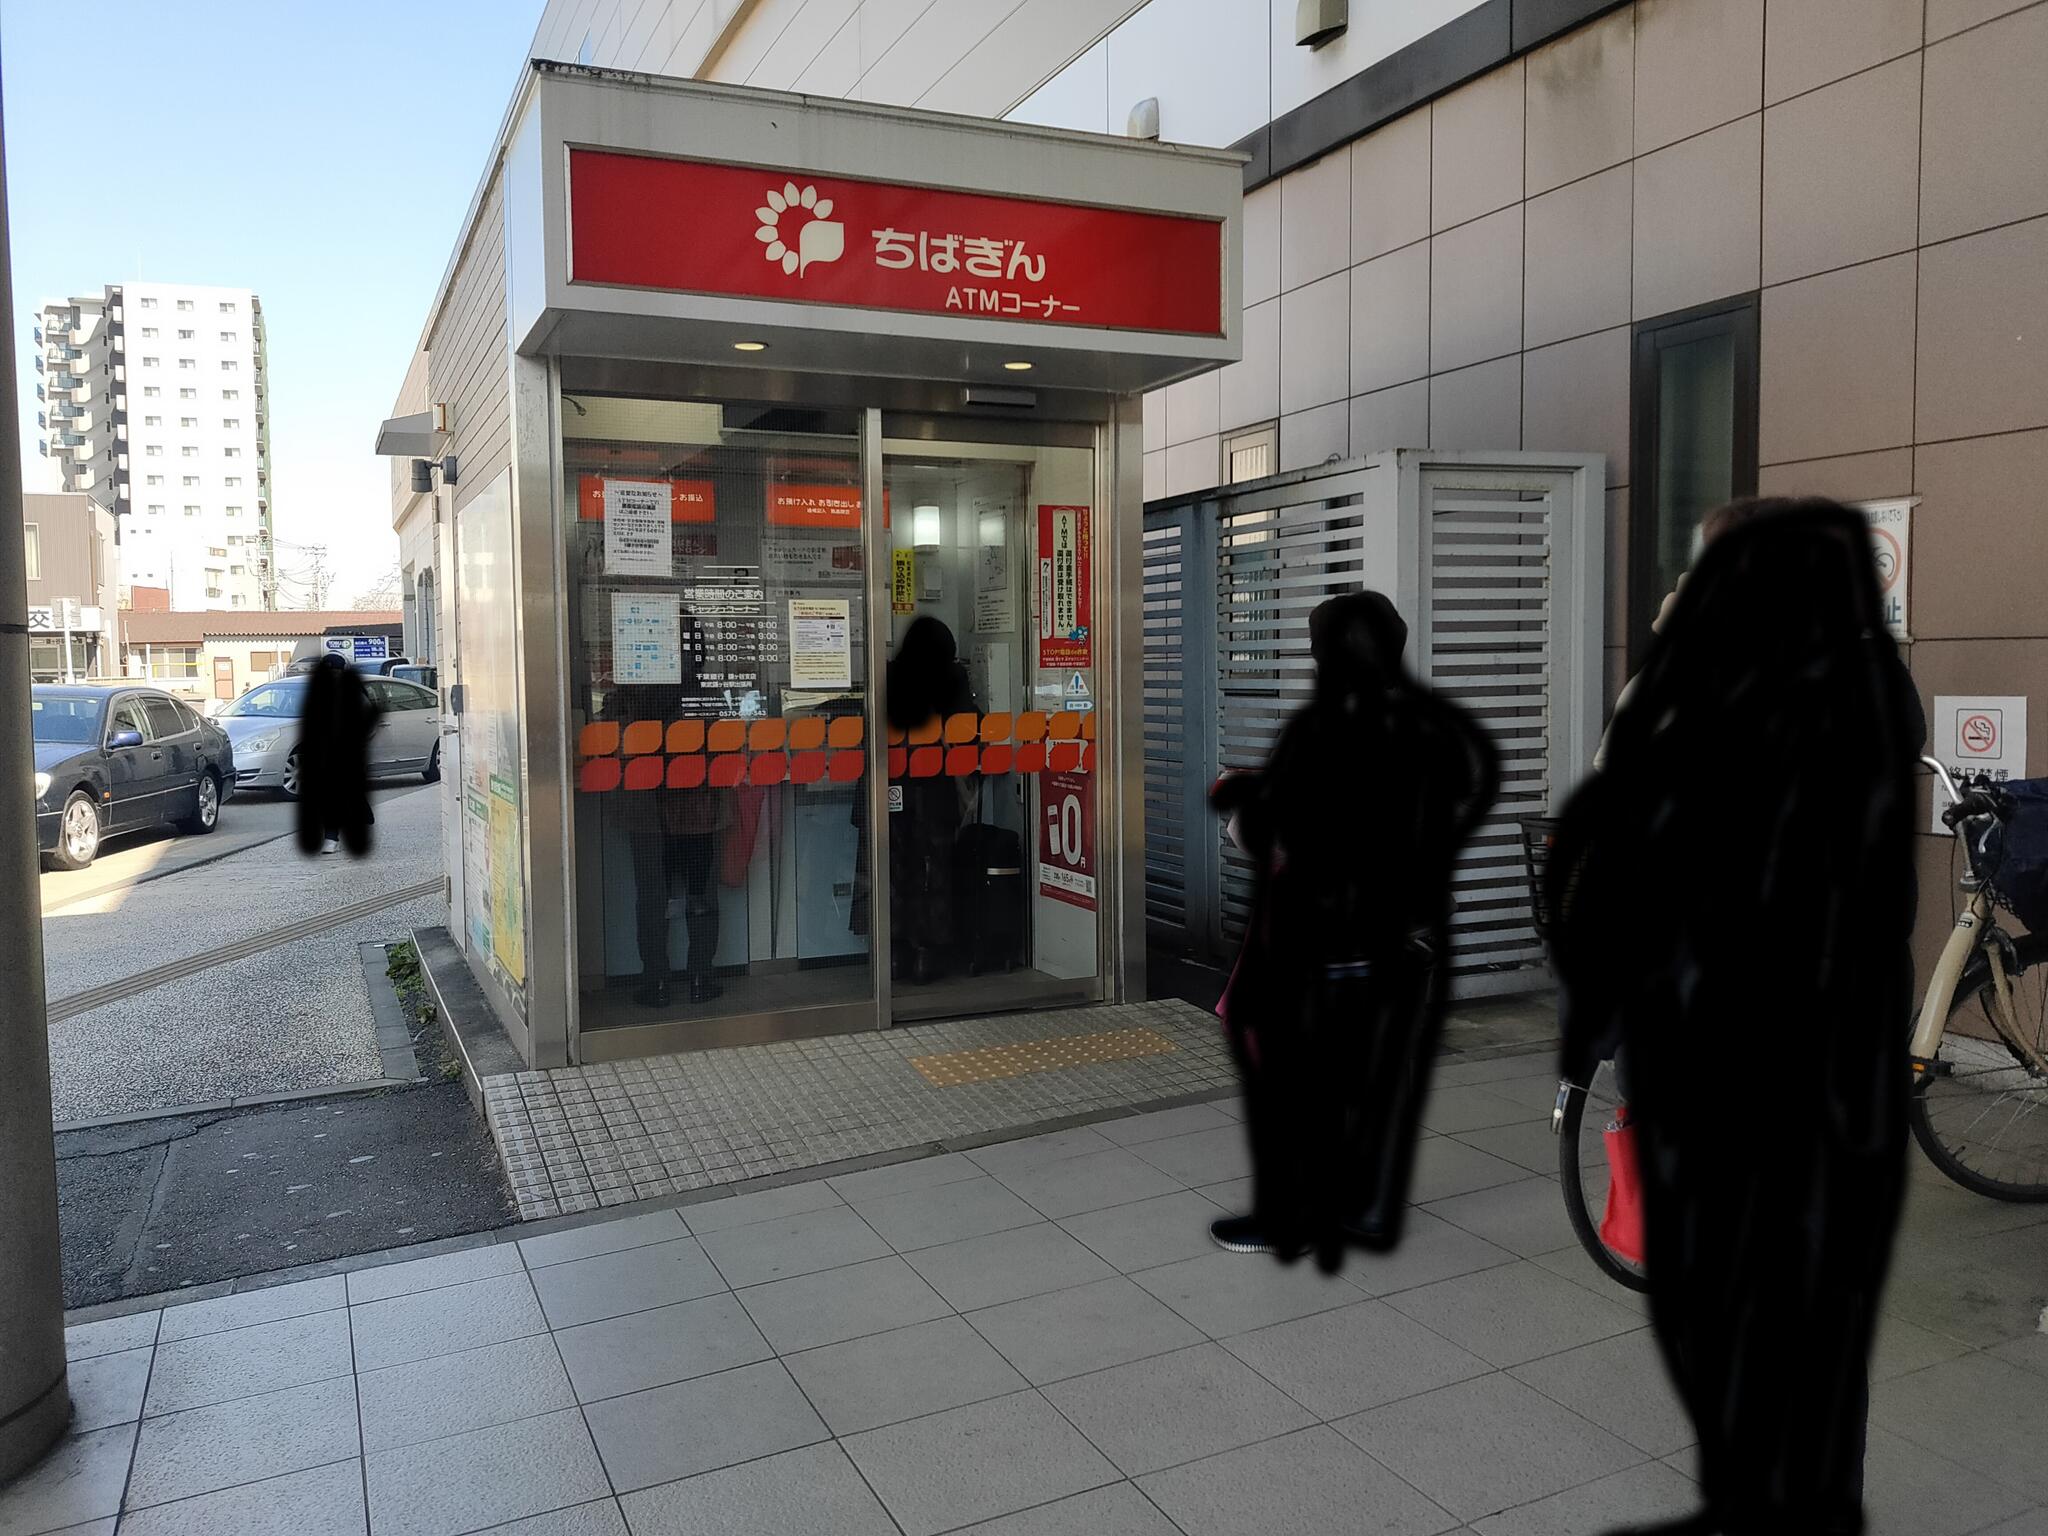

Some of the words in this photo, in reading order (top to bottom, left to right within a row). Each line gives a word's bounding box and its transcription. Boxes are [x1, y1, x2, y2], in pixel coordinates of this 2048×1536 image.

[872, 228, 1046, 282] ちばぎん
[945, 286, 1080, 318] ATMコーナー
[1060, 515, 1068, 549] ATMでは
[683, 588, 764, 601] 営業時間のご案内
